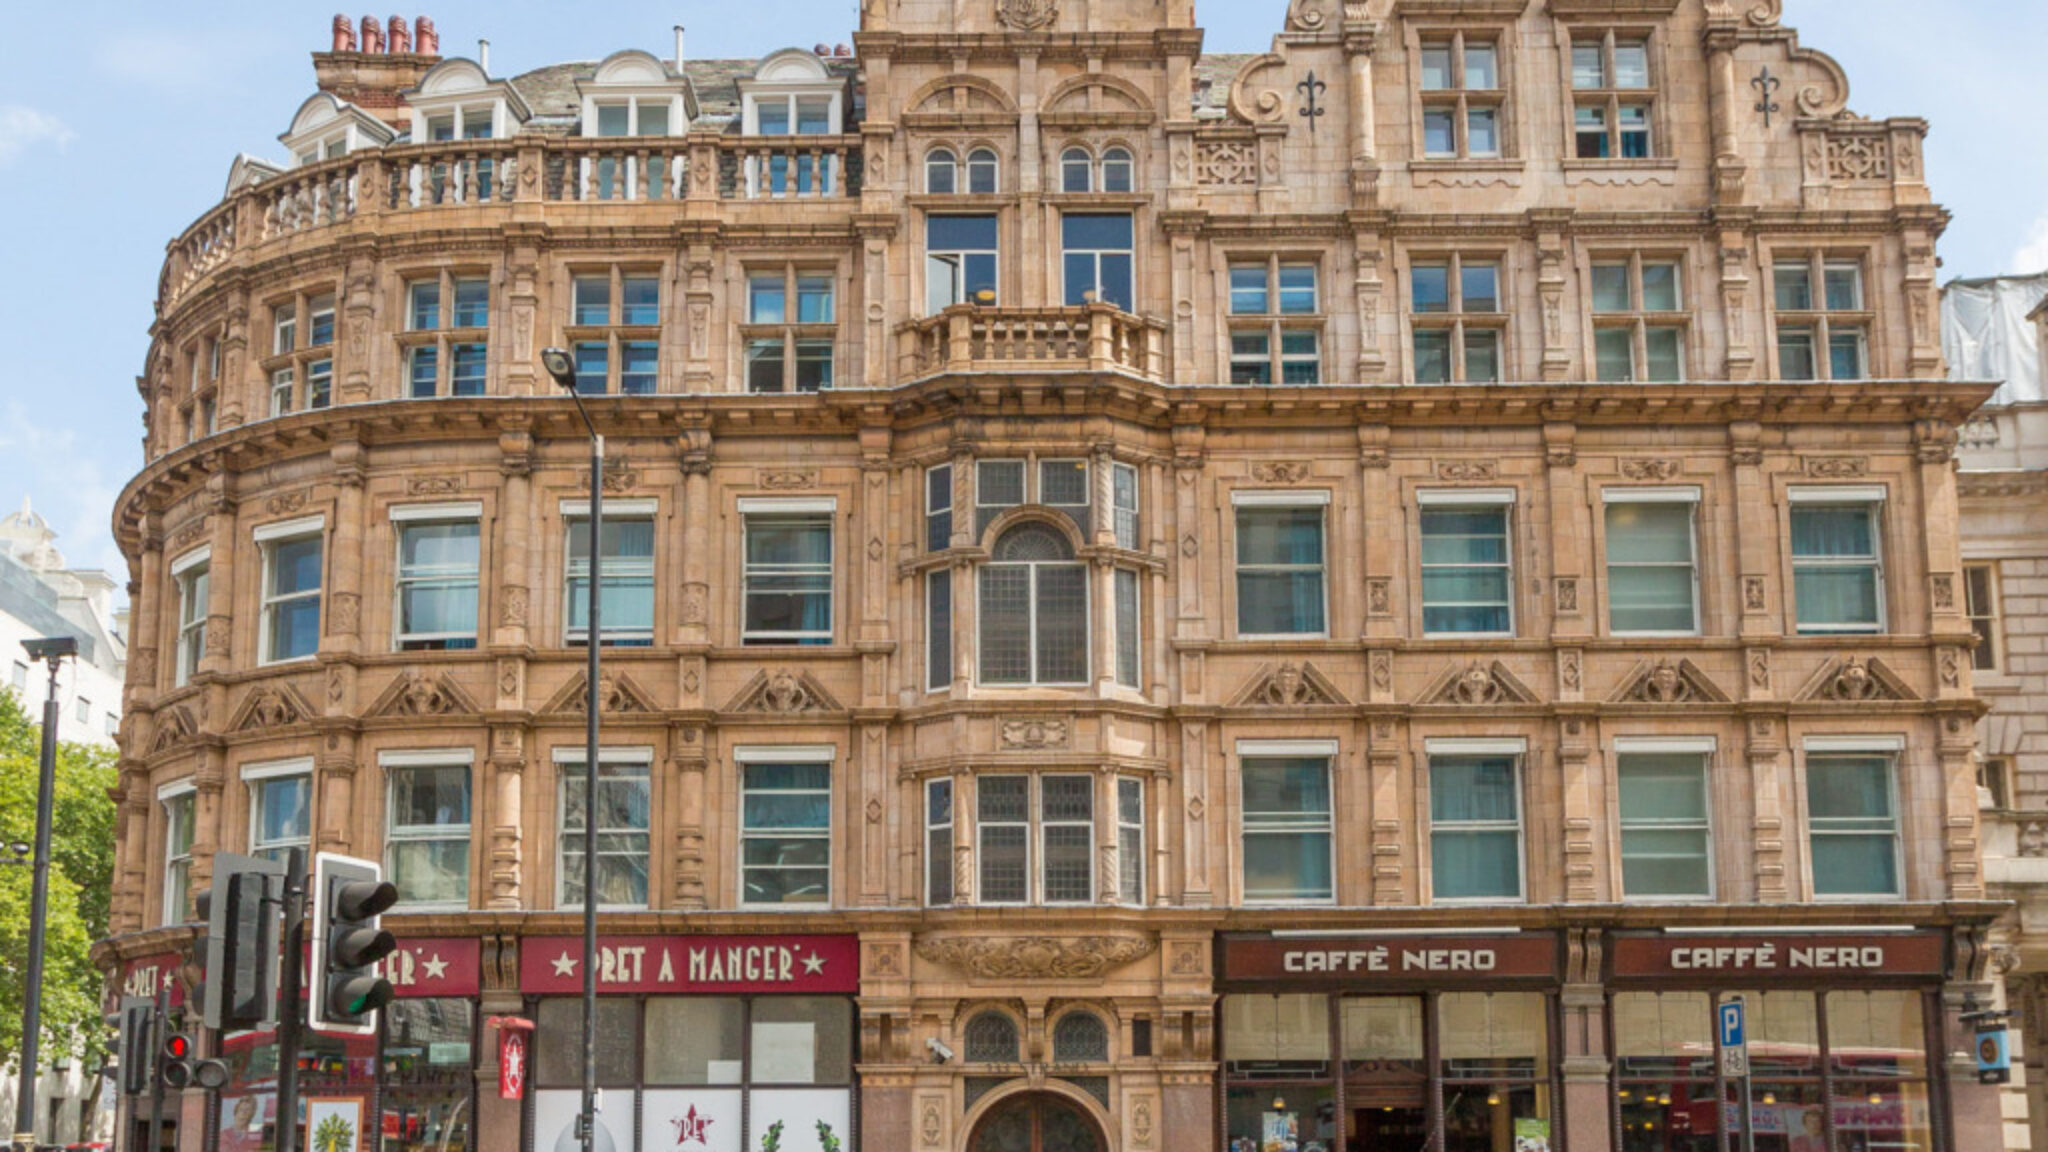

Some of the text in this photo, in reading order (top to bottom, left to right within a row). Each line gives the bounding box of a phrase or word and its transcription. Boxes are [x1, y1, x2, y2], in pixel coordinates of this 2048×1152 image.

[658, 947, 675, 982] A
[689, 946, 794, 981] MANGER
[1284, 946, 1495, 971] CAFFÈ NERO
[1671, 942, 1883, 968] CAFFÈ NERO
[1724, 1008, 1738, 1042] P
